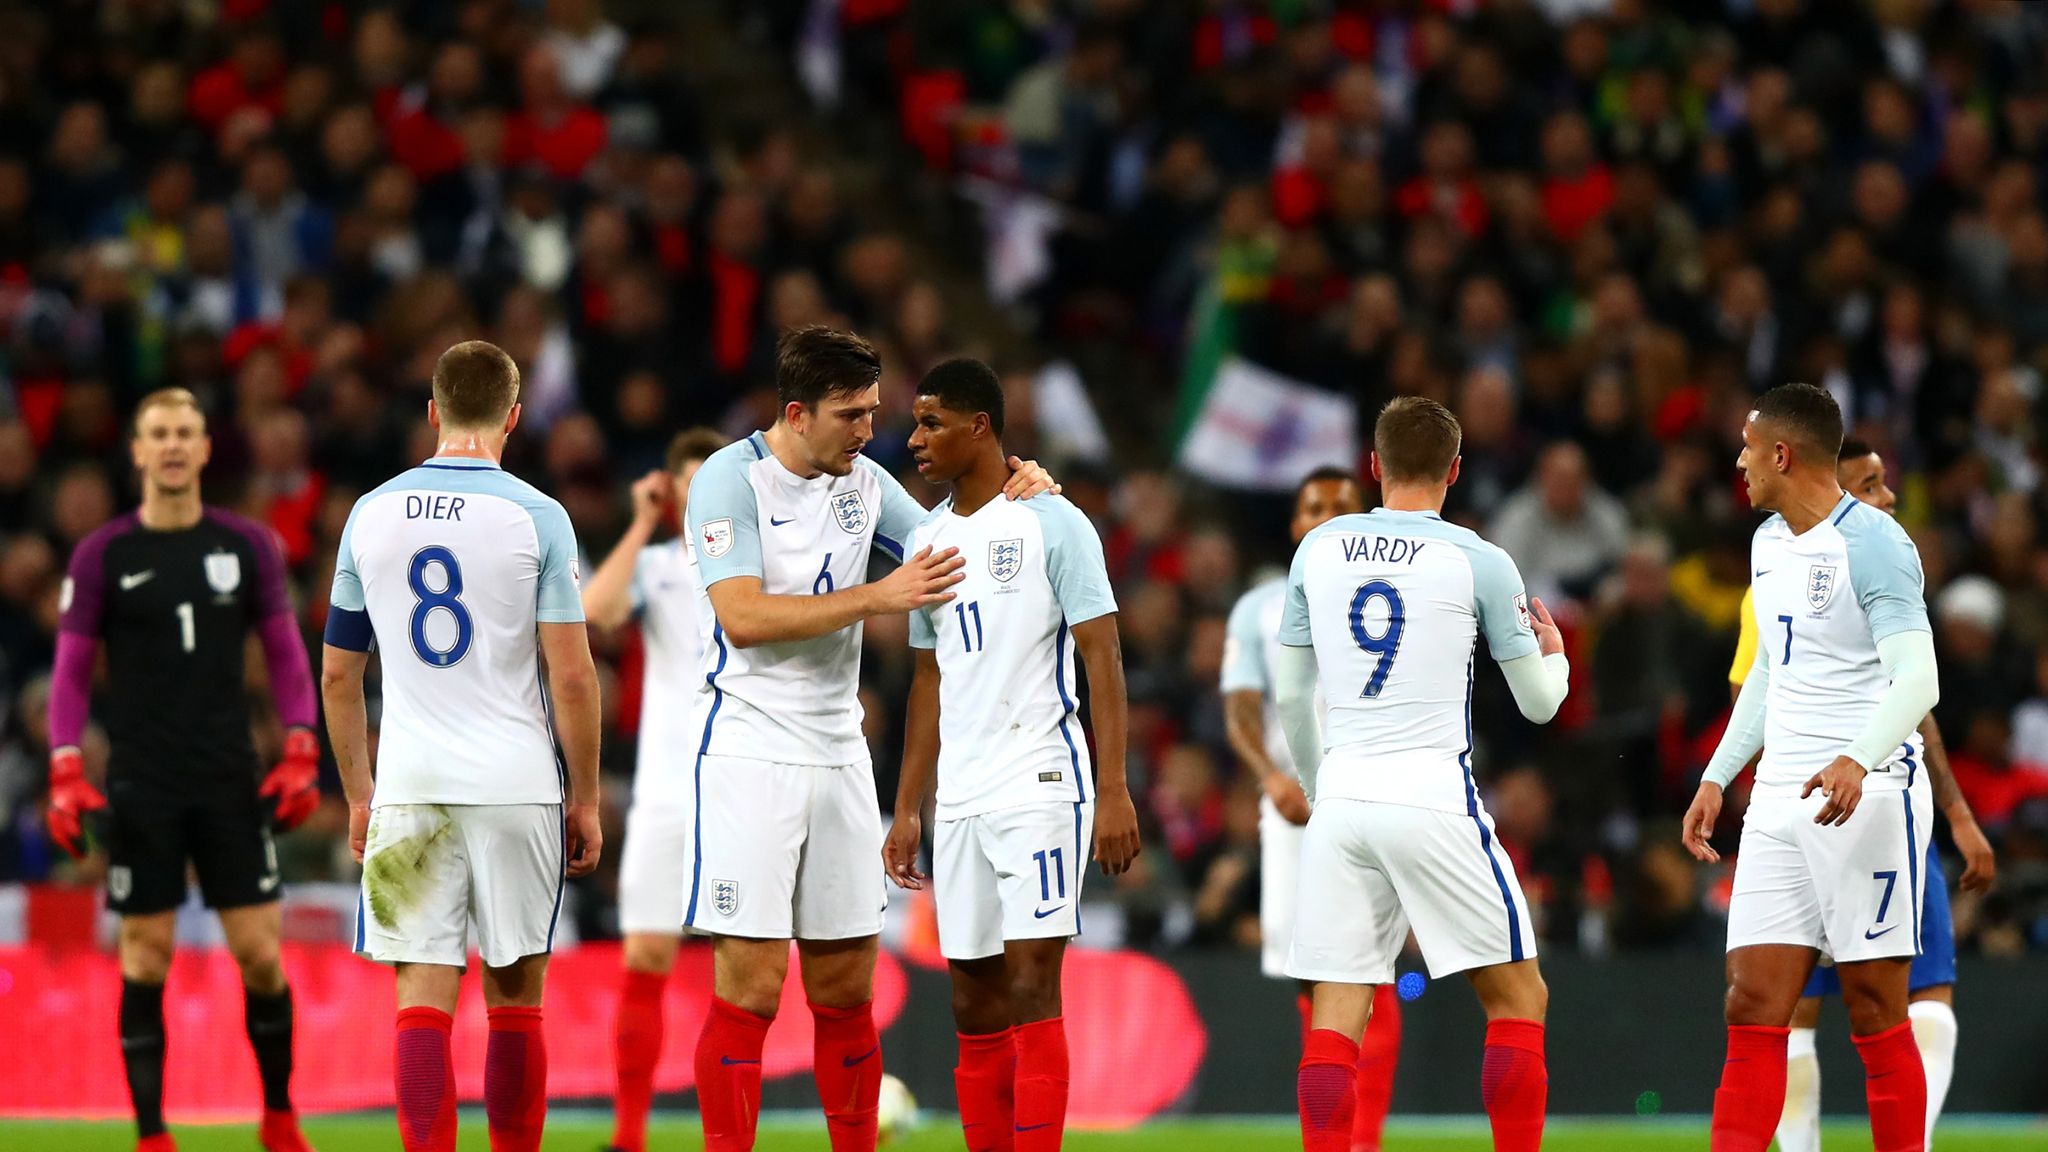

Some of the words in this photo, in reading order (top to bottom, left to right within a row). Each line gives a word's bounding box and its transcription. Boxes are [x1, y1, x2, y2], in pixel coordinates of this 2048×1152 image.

[406, 495, 465, 521] DIER
[812, 552, 834, 596] 6
[1342, 536, 1426, 565] VARDY
[175, 602, 196, 652] 1
[408, 545, 474, 668] 8
[955, 600, 983, 653] 11
[1347, 581, 1405, 698] 9
[1777, 614, 1793, 666] 7
[1032, 847, 1065, 901] 11
[1872, 870, 1898, 924] 7
